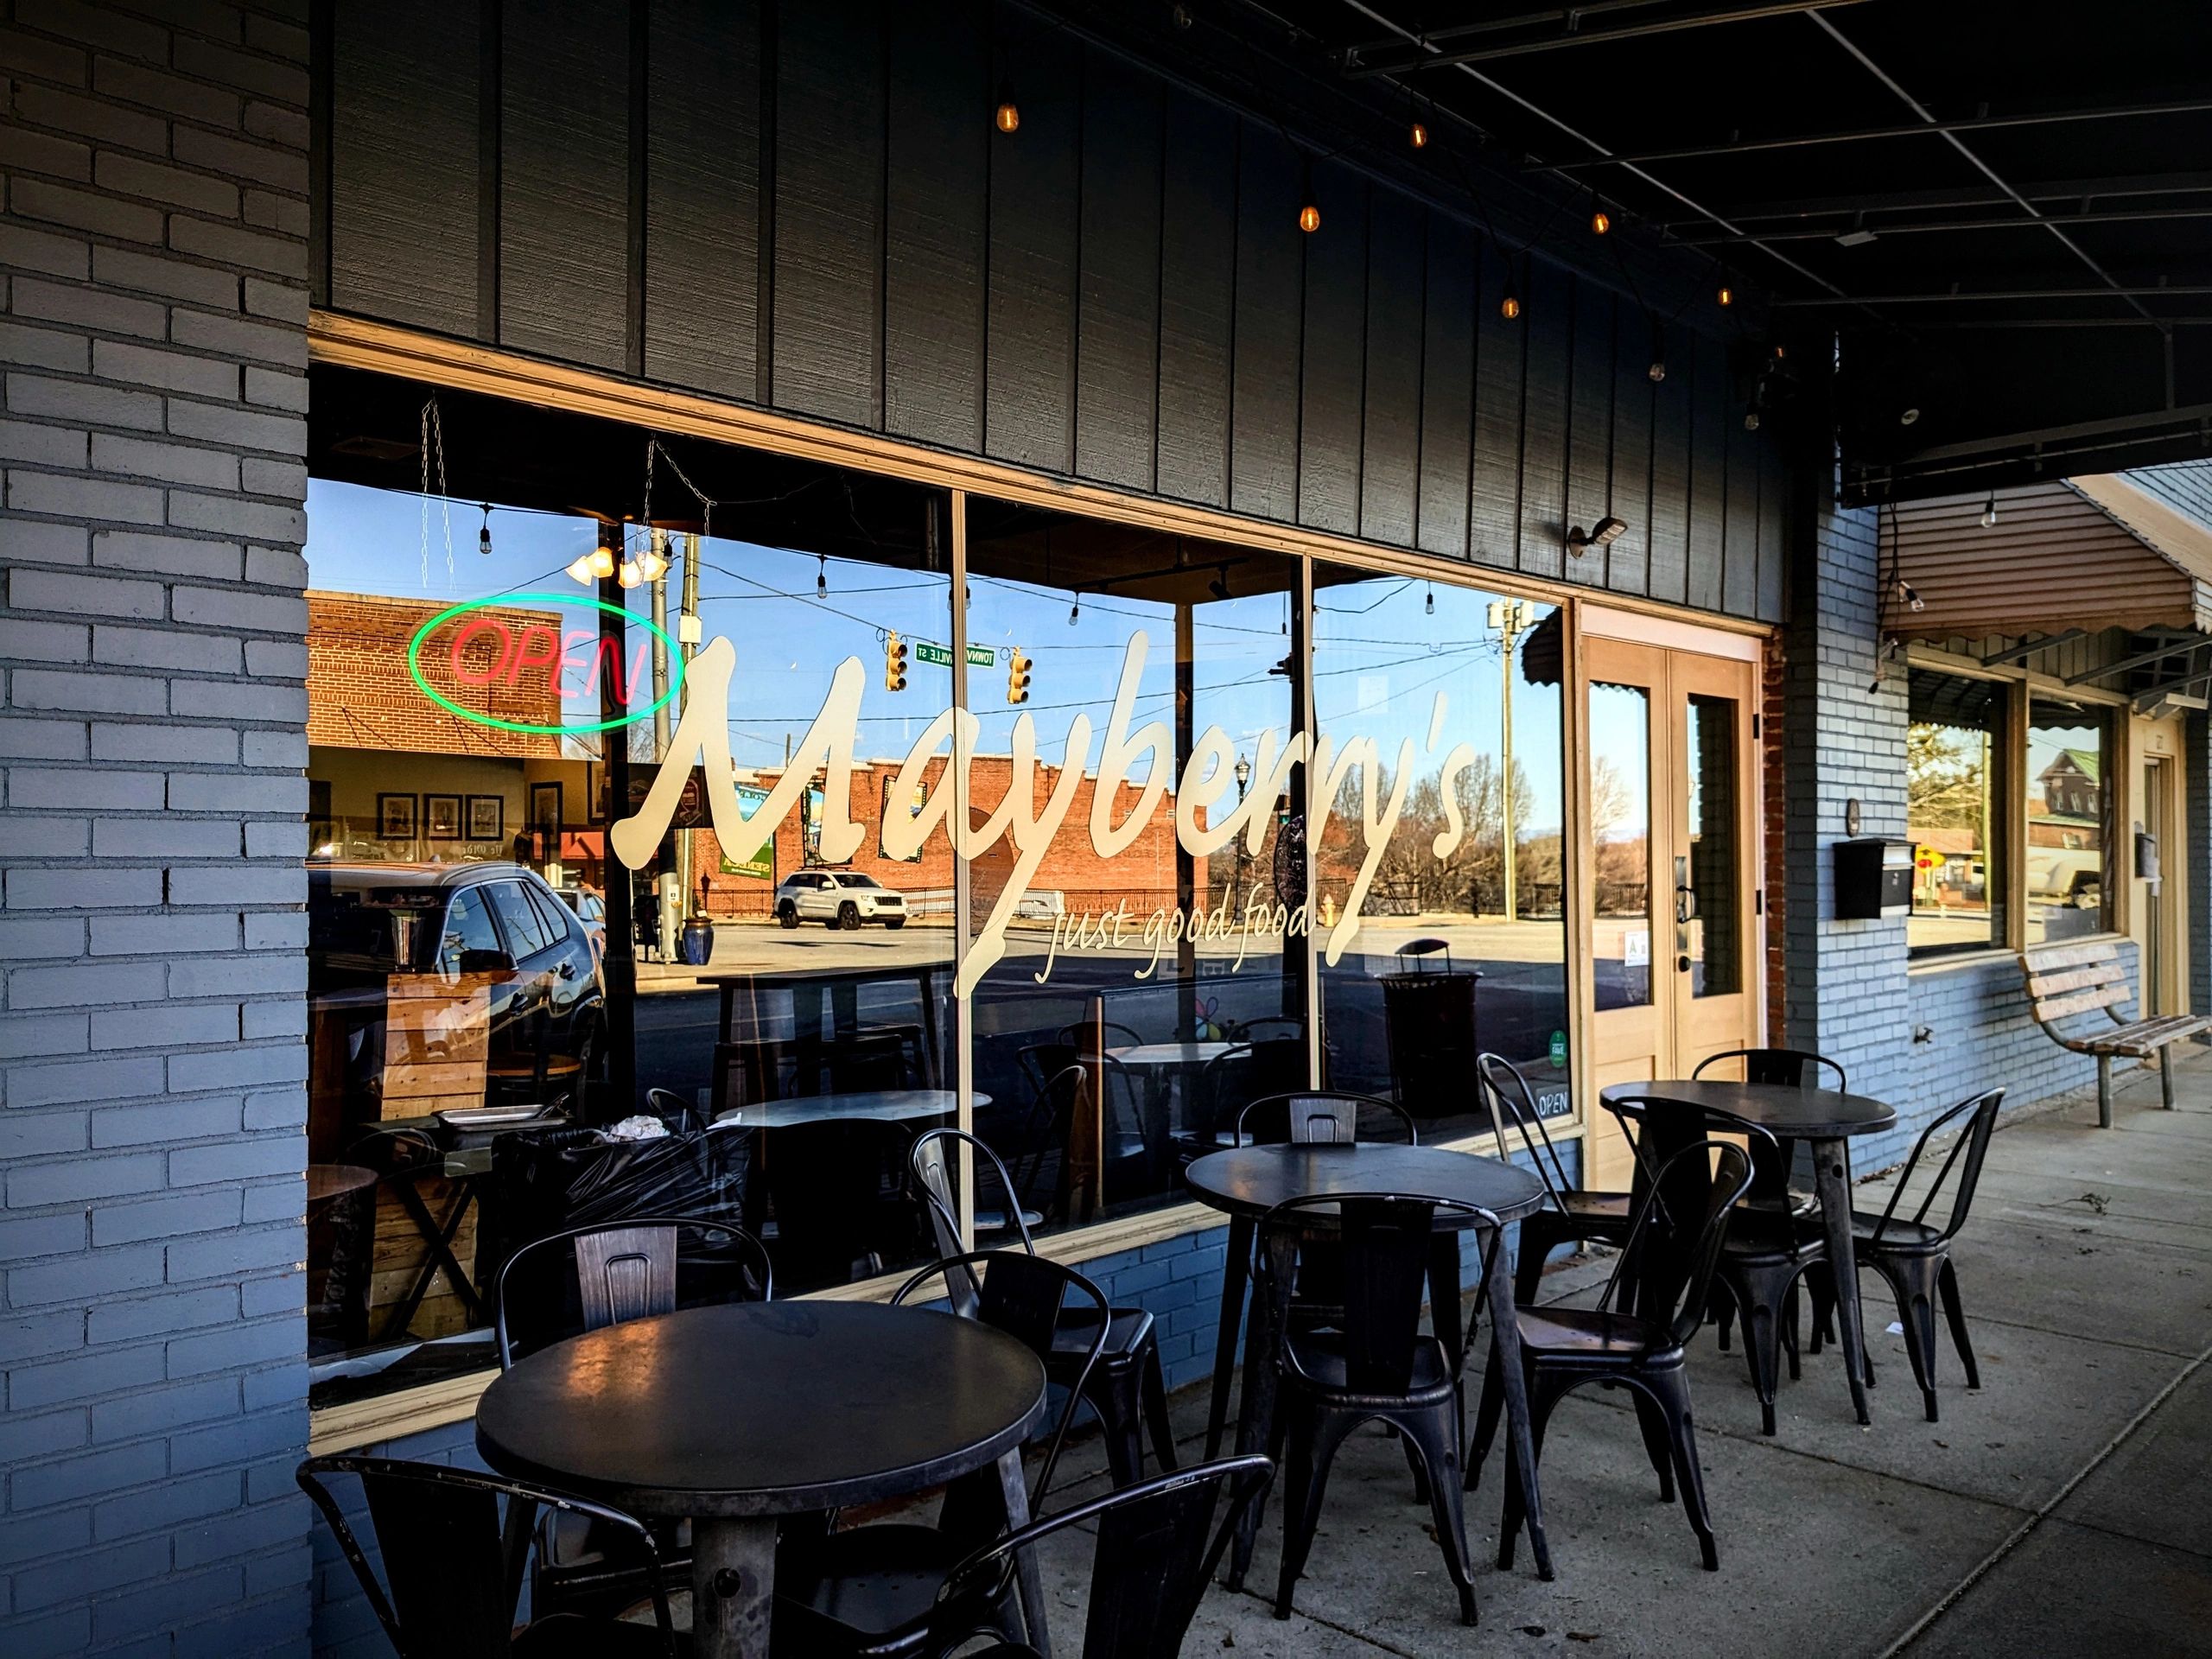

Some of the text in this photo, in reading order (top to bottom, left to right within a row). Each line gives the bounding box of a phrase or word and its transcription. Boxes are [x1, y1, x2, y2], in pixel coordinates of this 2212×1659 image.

[451, 619, 647, 705] OPEN
[610, 629, 1476, 1001] Mayberry's
[1034, 881, 1317, 984] just good food
[1539, 1091, 1568, 1116] OPEN
